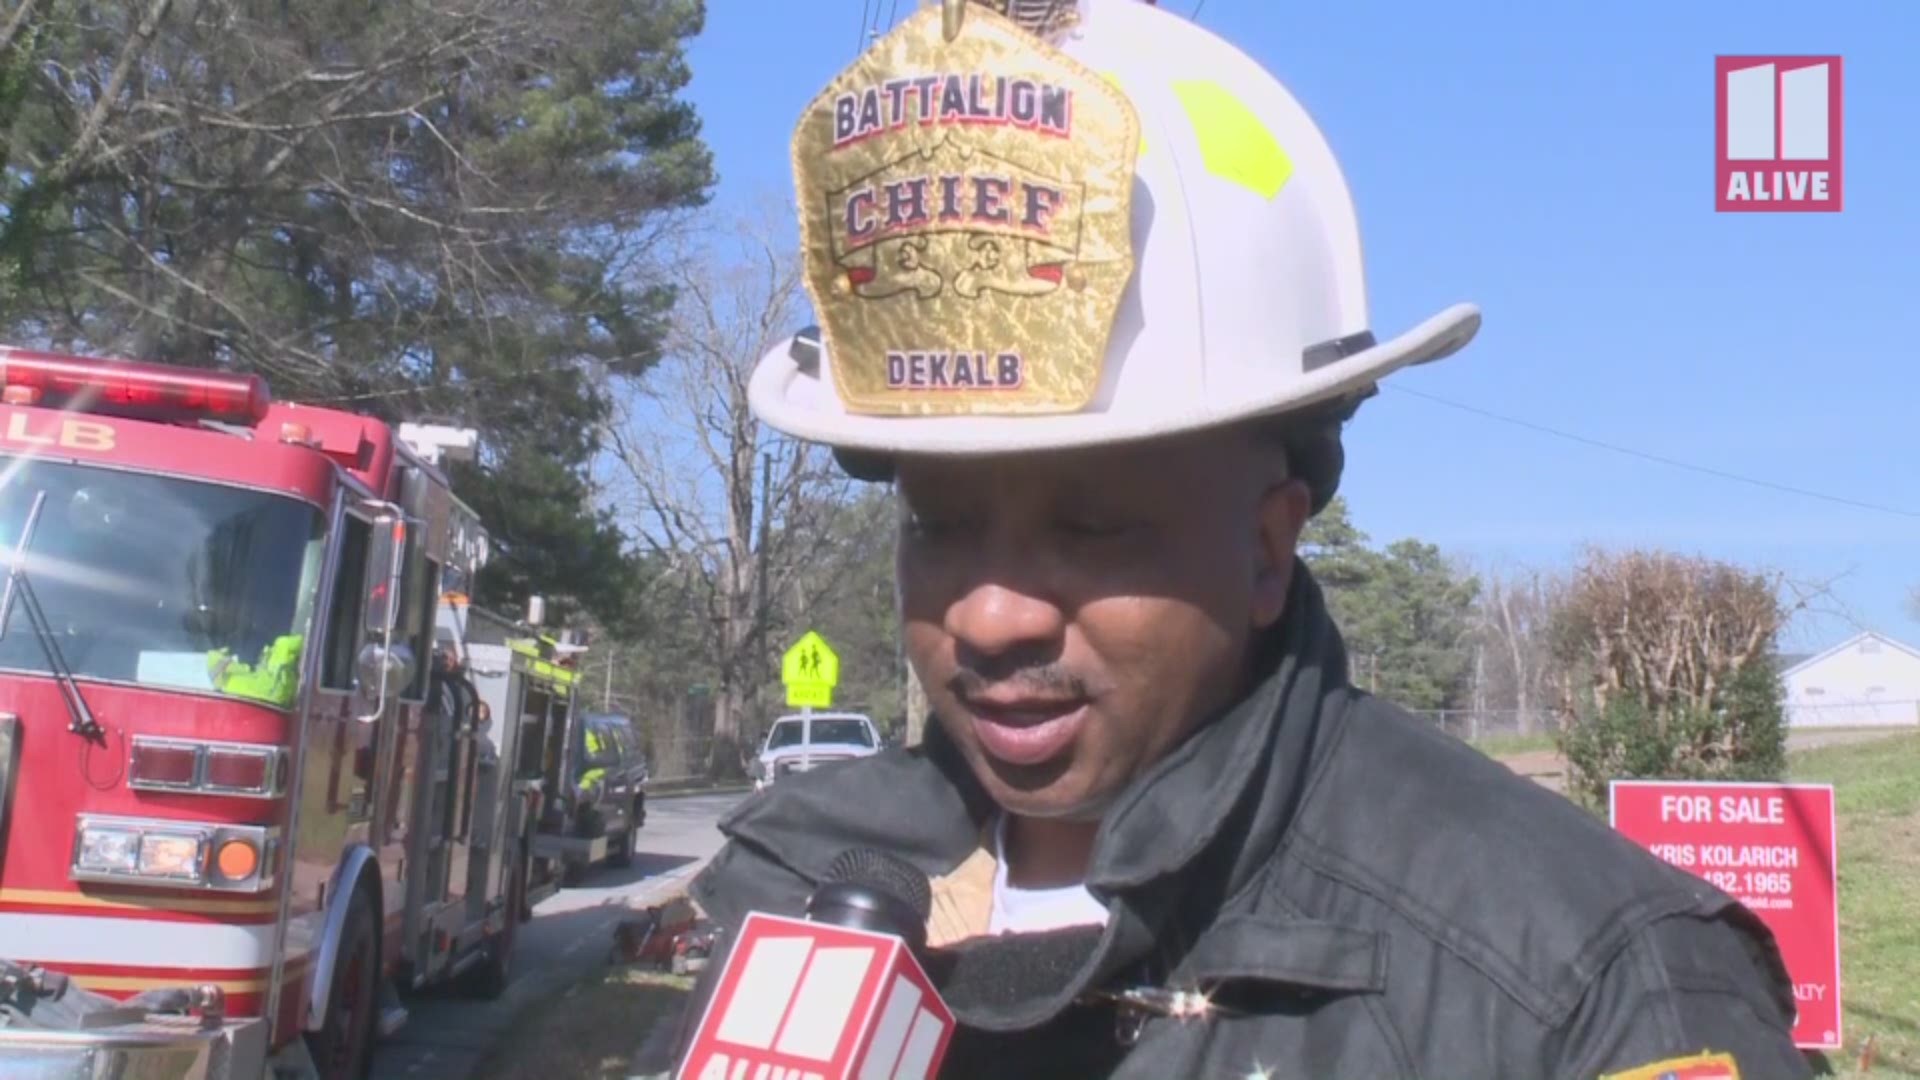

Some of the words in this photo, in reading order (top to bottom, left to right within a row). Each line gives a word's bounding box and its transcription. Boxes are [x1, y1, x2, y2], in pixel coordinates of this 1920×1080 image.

[833, 73, 1072, 147] BATTALION
[845, 171, 1061, 243] CHIEF
[886, 350, 1022, 389] DEKALB
[1661, 796, 1712, 822] FOR
[1719, 797, 1785, 824] SALE
[1701, 845, 1798, 868] KOLARICH
[697, 1052, 826, 1080] ALIV
